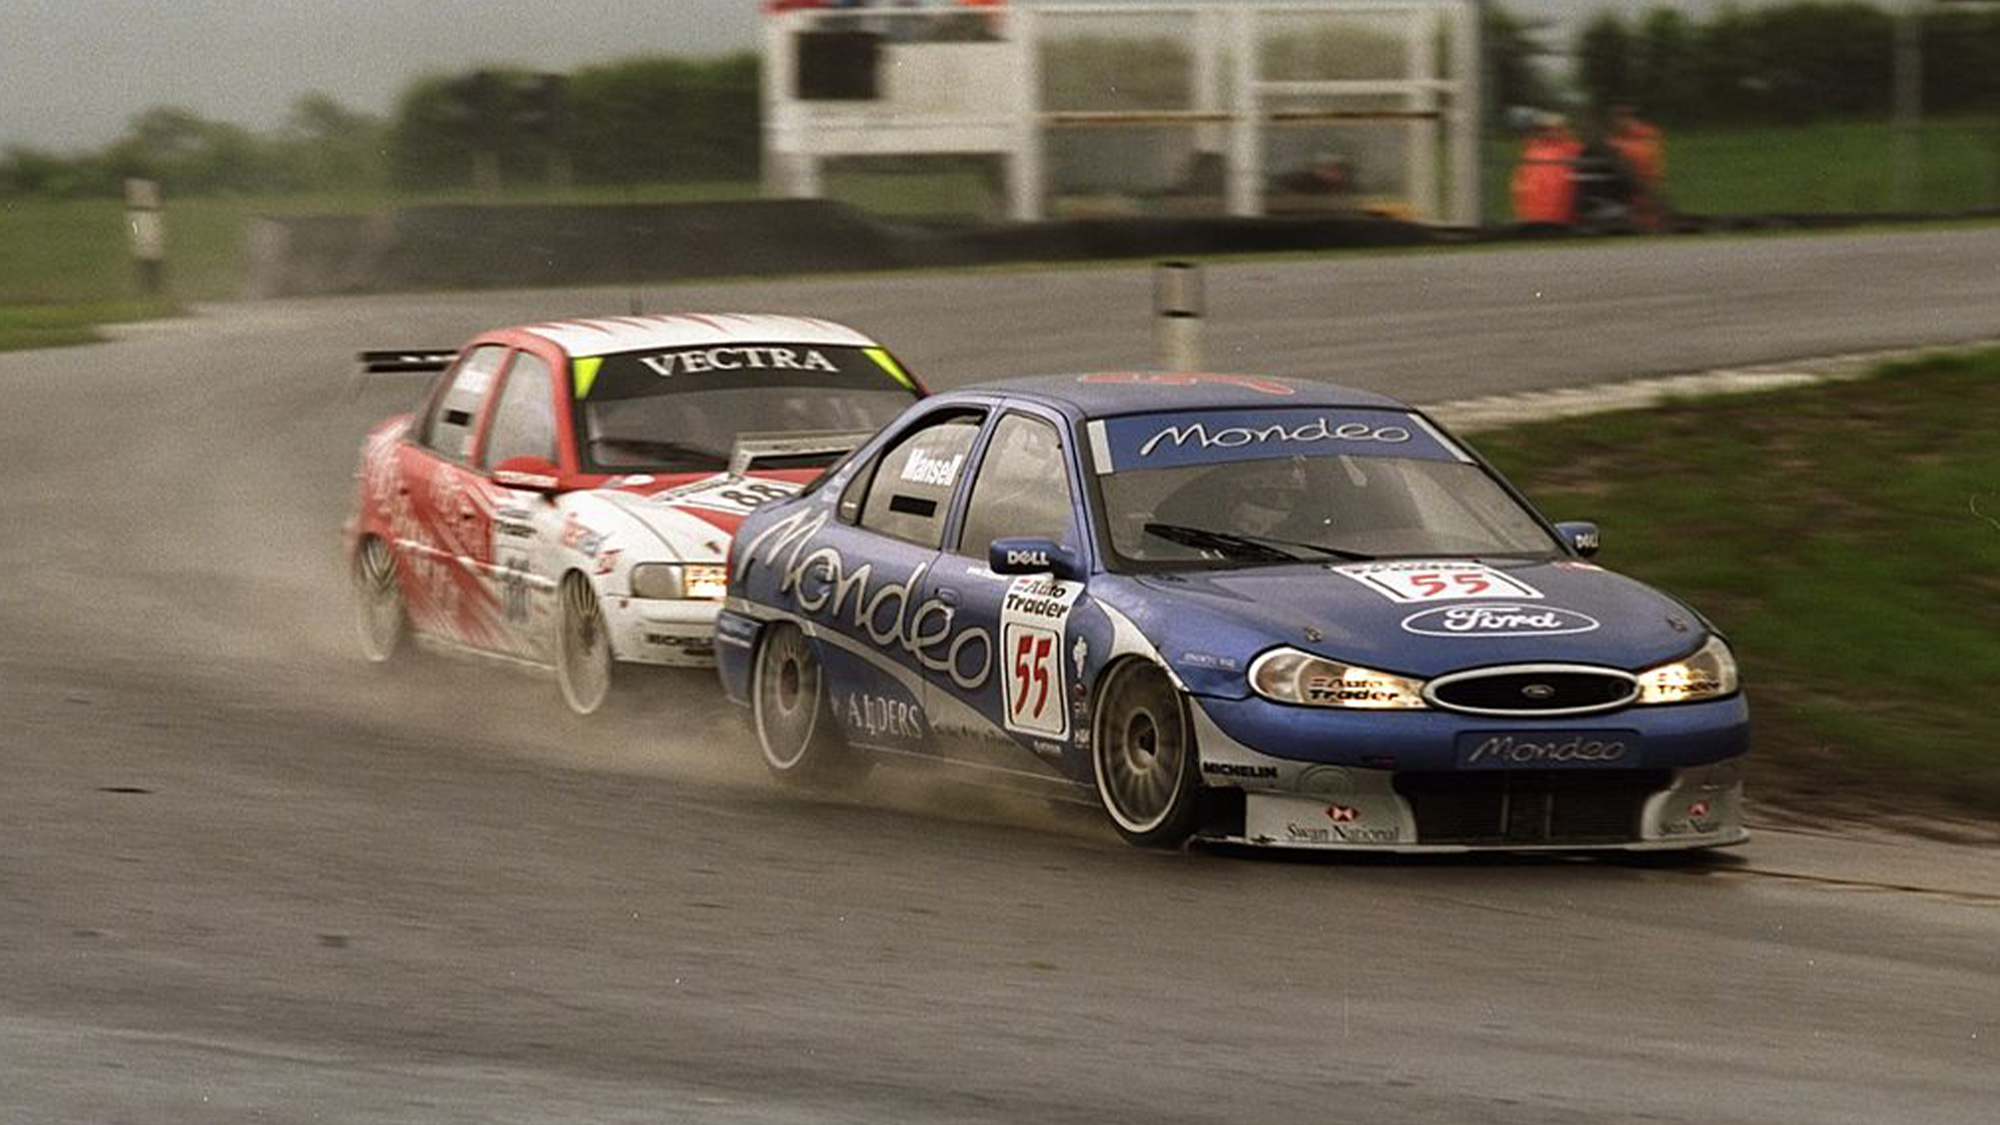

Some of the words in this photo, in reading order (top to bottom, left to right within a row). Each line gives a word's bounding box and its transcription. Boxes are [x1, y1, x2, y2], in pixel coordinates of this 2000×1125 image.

[638, 347, 840, 376] VECTRA
[1140, 417, 1411, 456] Mondeo
[901, 448, 963, 487] Mansell
[1007, 550, 1050, 566] DELL
[734, 507, 992, 689] Mondeo
[1023, 580, 1067, 599] Auto
[1410, 574, 1490, 597] 55
[1006, 594, 1069, 619] Trader
[1443, 606, 1562, 631] Ford
[1015, 635, 1053, 720] 55
[1326, 677, 1383, 689] Auto
[1310, 688, 1399, 701] Trader
[1469, 736, 1626, 763] Mondeo
[1203, 761, 1278, 779] MICHELIN
[1288, 823, 1328, 841] Swan
[1332, 824, 1400, 842] National
